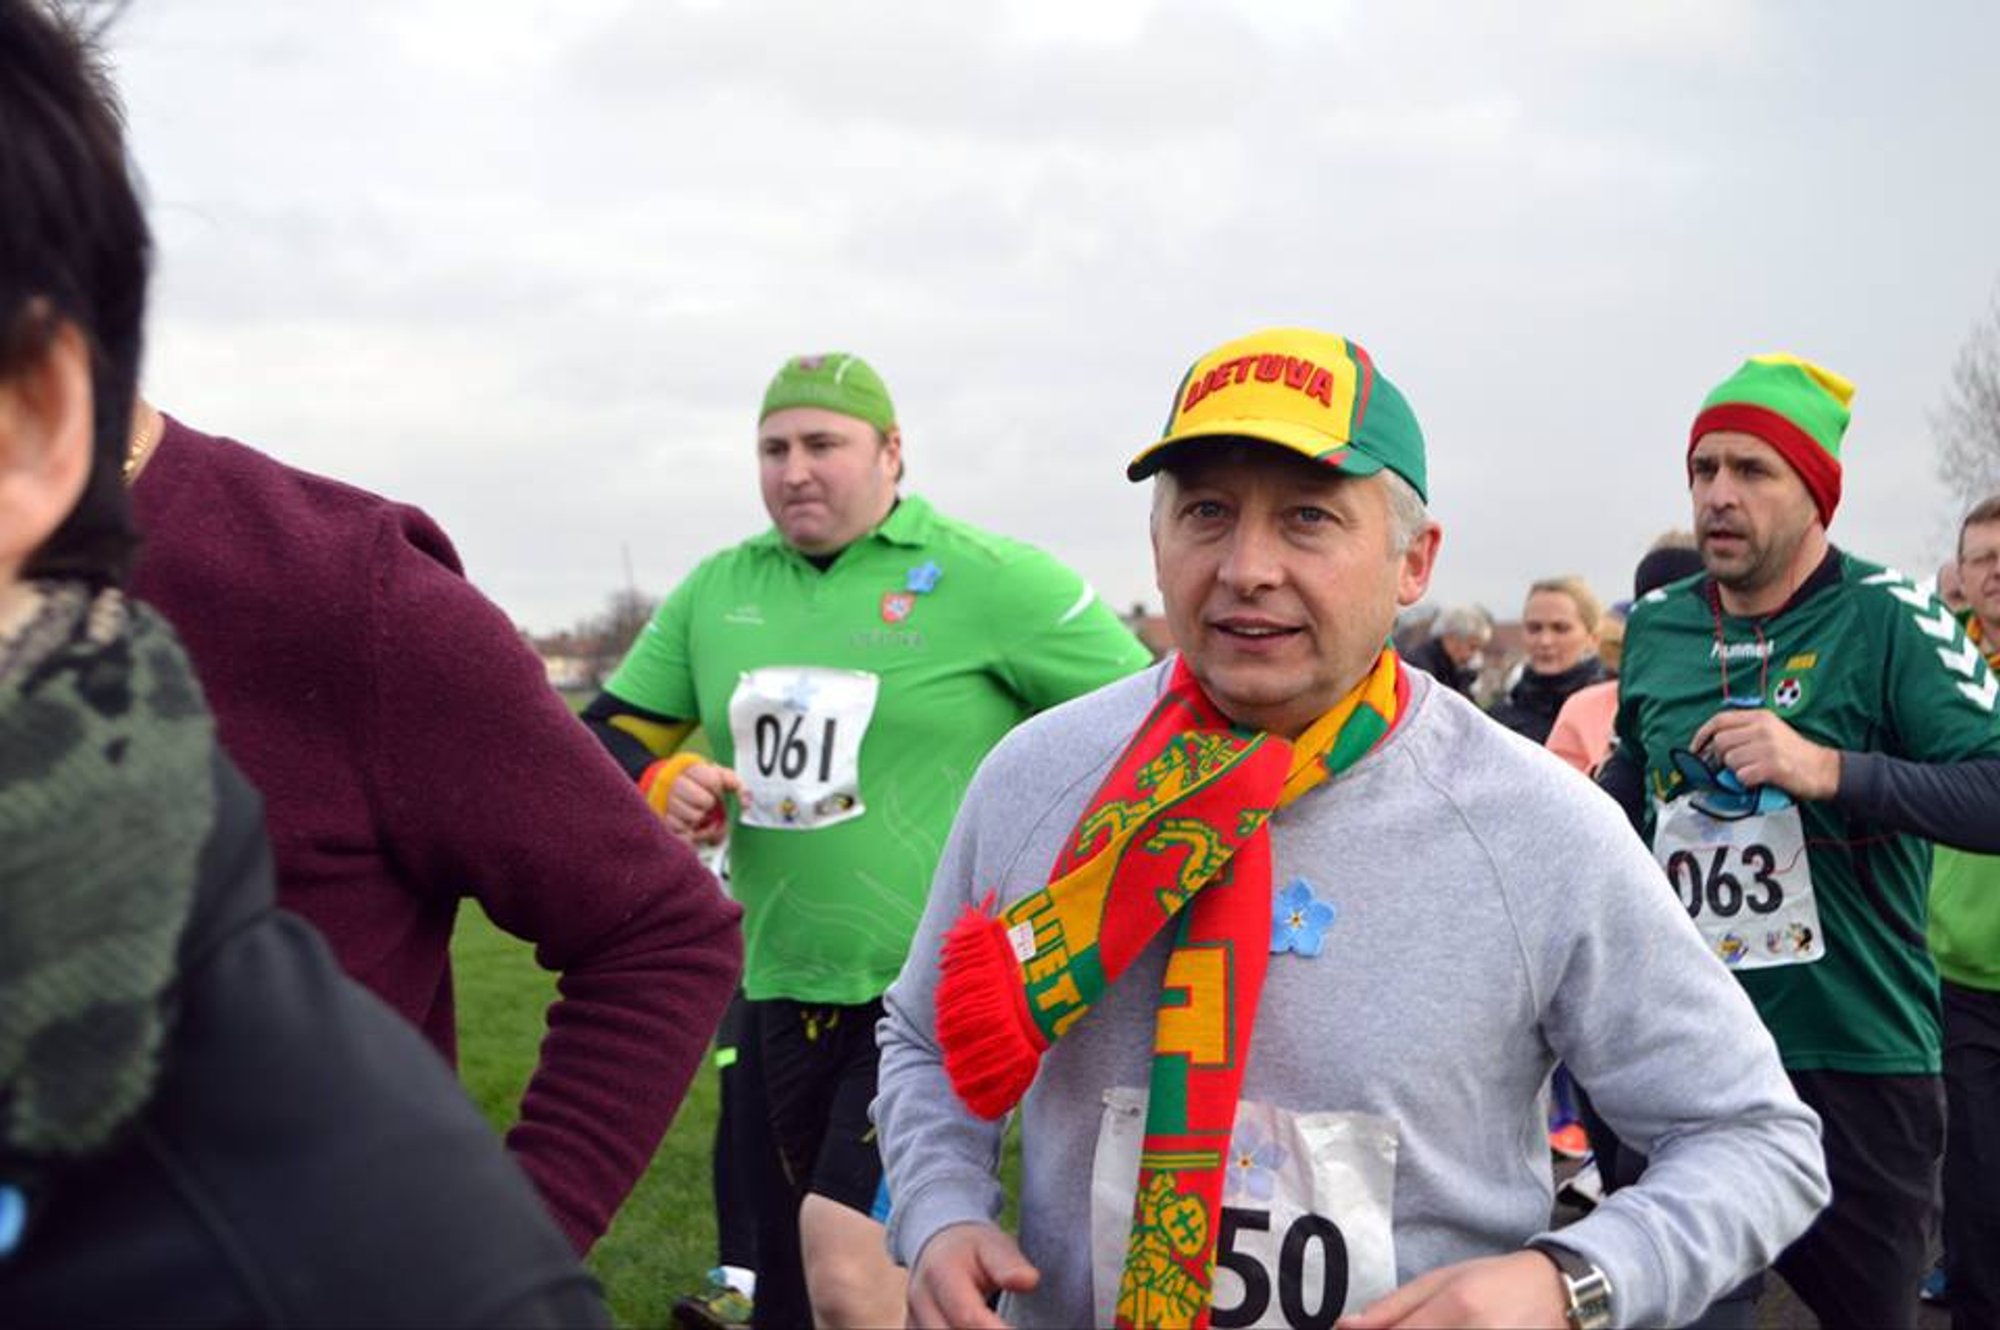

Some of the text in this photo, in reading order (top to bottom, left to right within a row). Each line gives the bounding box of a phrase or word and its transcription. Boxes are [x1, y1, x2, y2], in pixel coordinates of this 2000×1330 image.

[1183, 354, 1334, 408] LIETUVA
[755, 714, 836, 783] 061
[1667, 844, 1783, 918] 063
